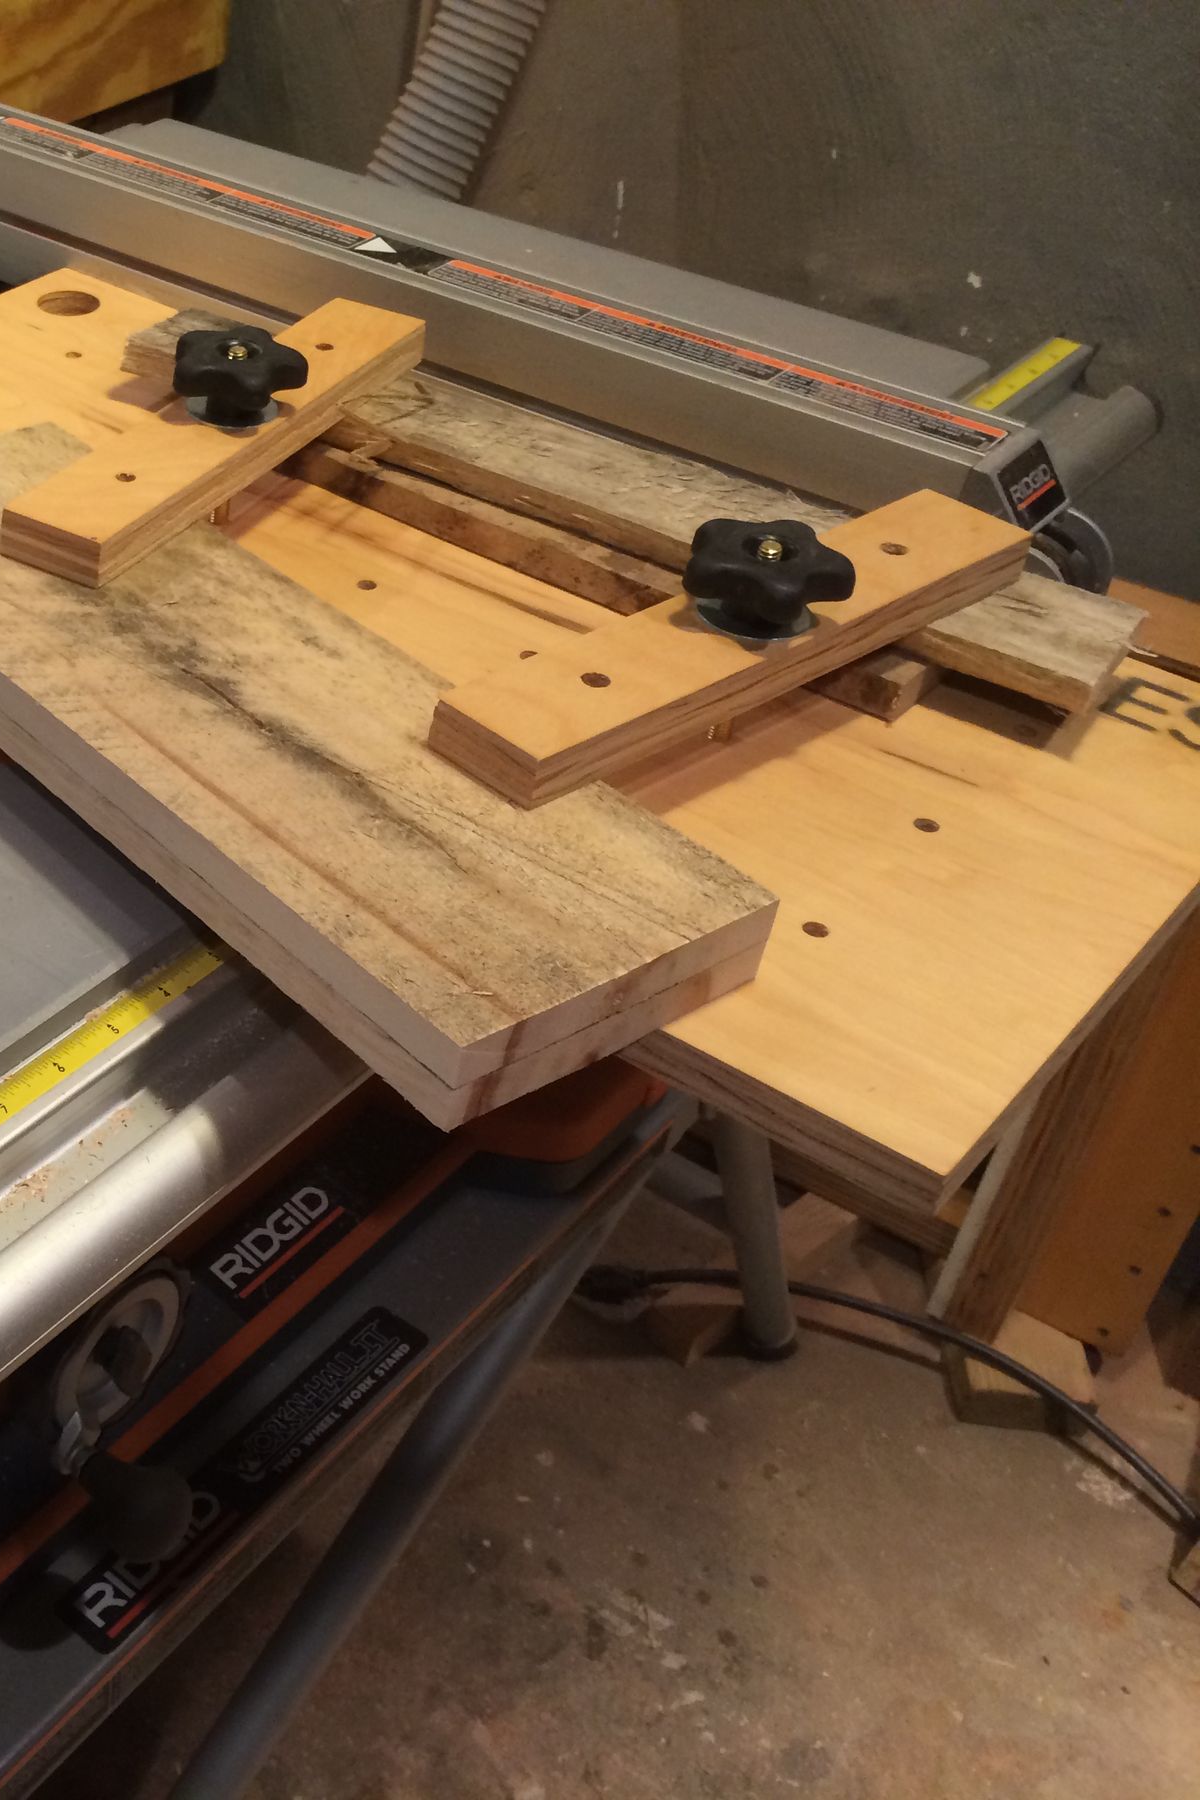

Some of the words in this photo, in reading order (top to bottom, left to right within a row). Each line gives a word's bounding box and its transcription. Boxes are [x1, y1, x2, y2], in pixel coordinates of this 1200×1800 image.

[1009, 463, 1051, 506] RIDGID
[209, 1186, 329, 1290] RIDGID
[272, 1446, 303, 1473] TWO
[303, 1410, 342, 1447] WHEEL
[338, 1375, 377, 1411] WORK
[373, 1343, 411, 1378] STAND
